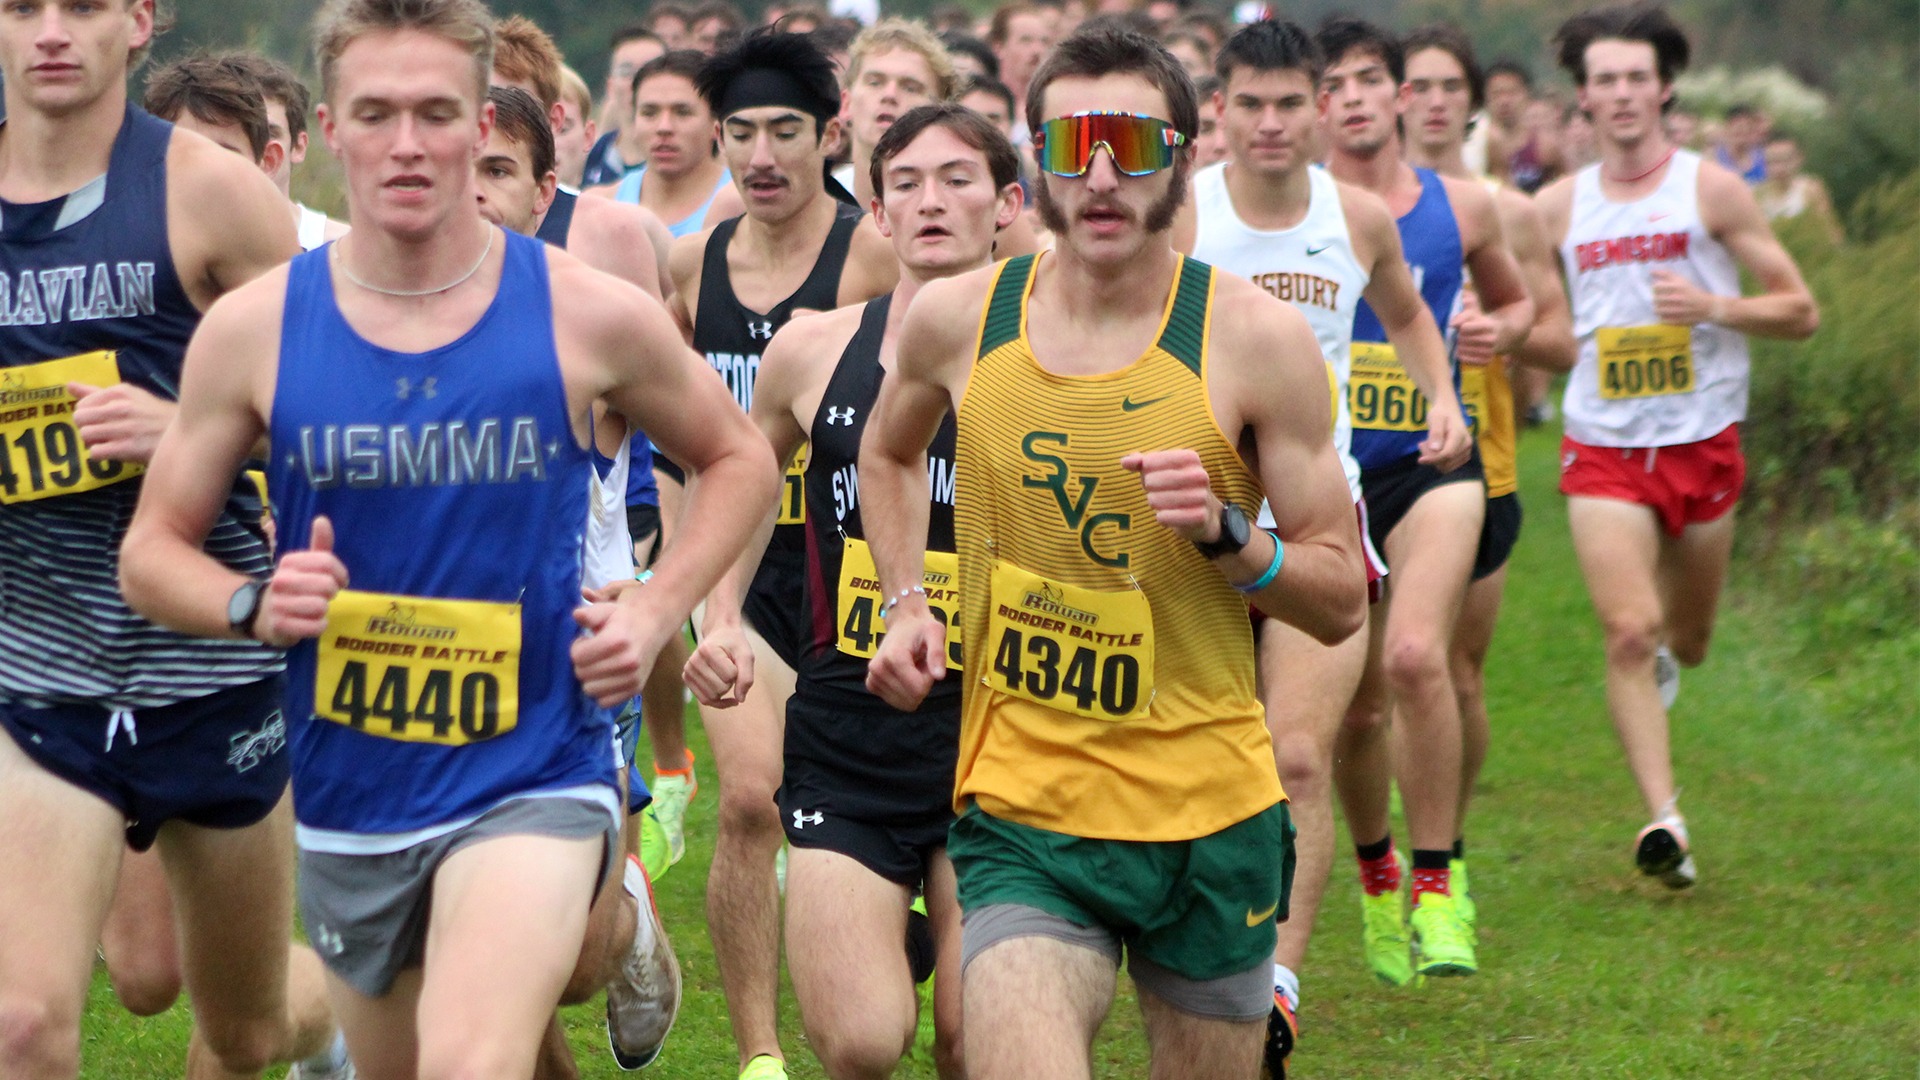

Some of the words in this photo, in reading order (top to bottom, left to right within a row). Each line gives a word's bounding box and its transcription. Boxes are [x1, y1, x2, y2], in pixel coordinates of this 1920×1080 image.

[1252, 272, 1340, 311] SBURY
[1605, 355, 1689, 393] 4006
[1346, 383, 1427, 425] 960
[300, 416, 546, 488] USMMA
[1021, 430, 1131, 569] SVC
[366, 616, 457, 641] Rowan
[997, 603, 1066, 634] BORDER
[1068, 625, 1144, 647] BATTLE
[1024, 593, 1098, 625] Rowan
[334, 635, 417, 659] BORDER
[420, 645, 509, 664] BATTLE
[993, 626, 1140, 717] 4340
[331, 660, 500, 740] 4440
